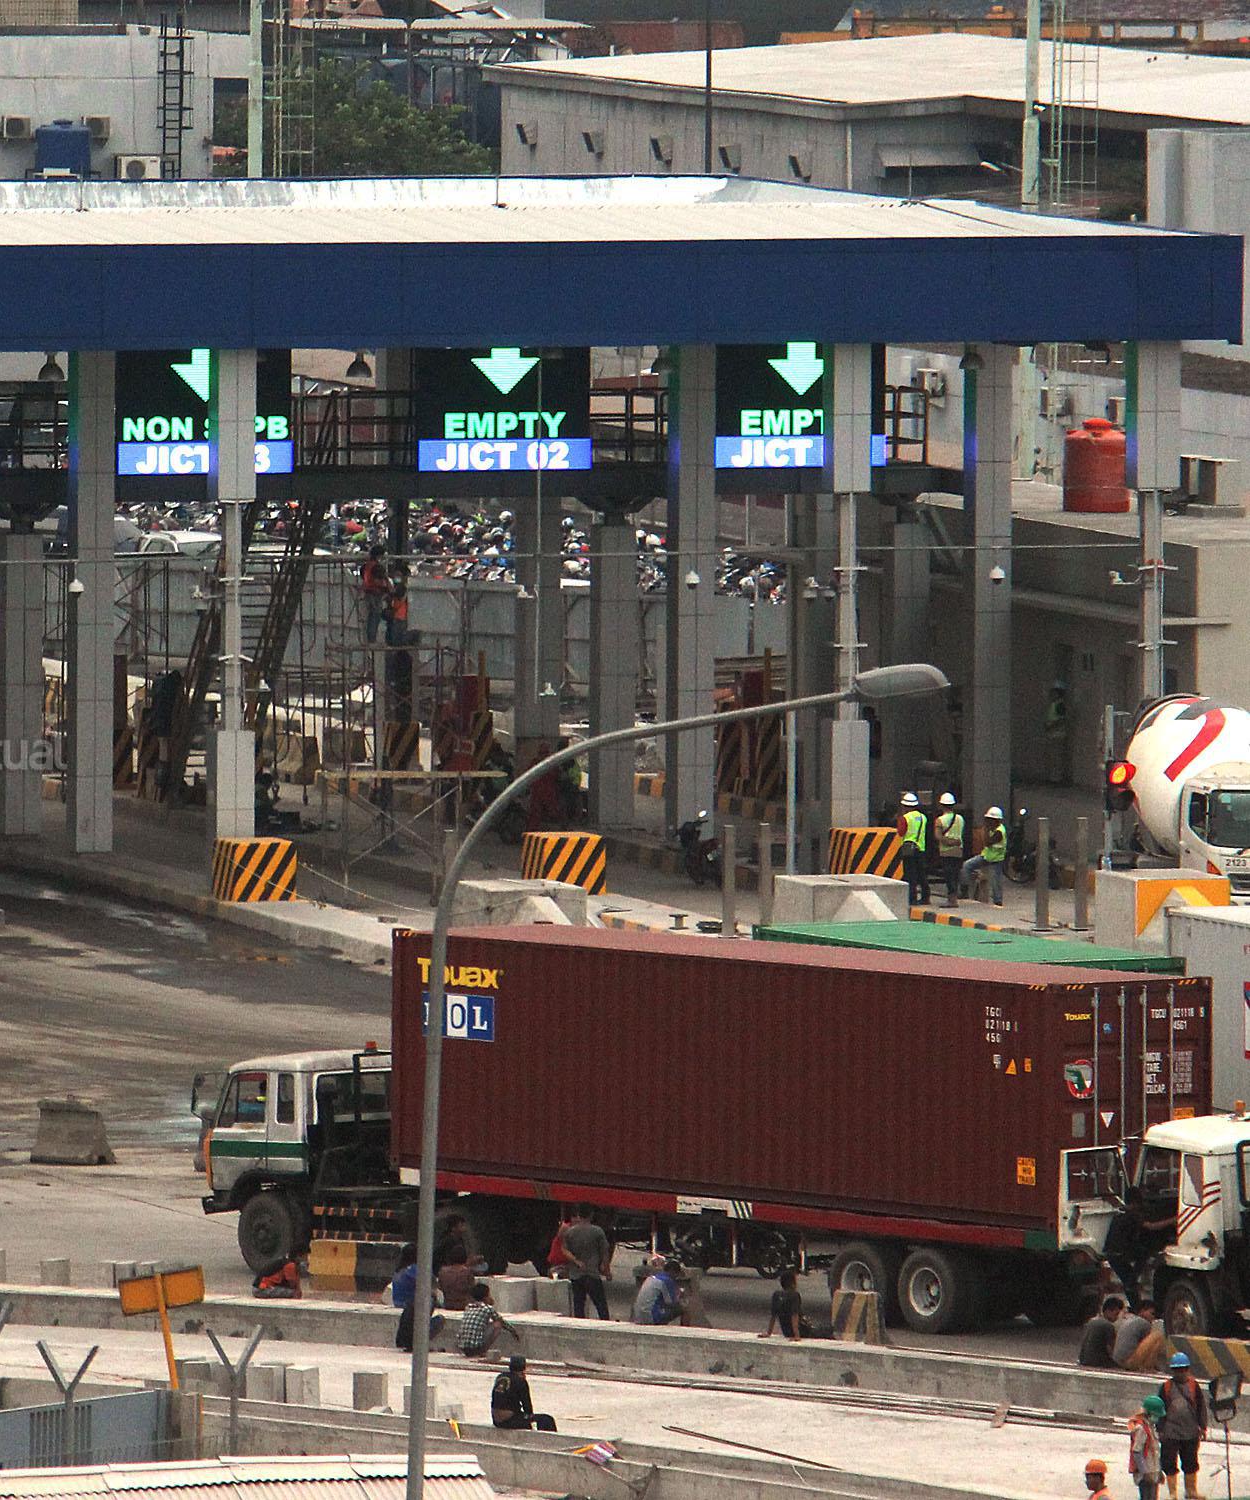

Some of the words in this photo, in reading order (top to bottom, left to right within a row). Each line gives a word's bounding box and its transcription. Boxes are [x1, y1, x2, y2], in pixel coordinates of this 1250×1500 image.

[122, 416, 193, 441] NON
[444, 411, 567, 439] EMPTY
[740, 409, 824, 436] EMPT
[254, 444, 271, 474] 3
[435, 442, 518, 471] JICT
[526, 441, 570, 470] 02
[731, 438, 814, 467] JICT
